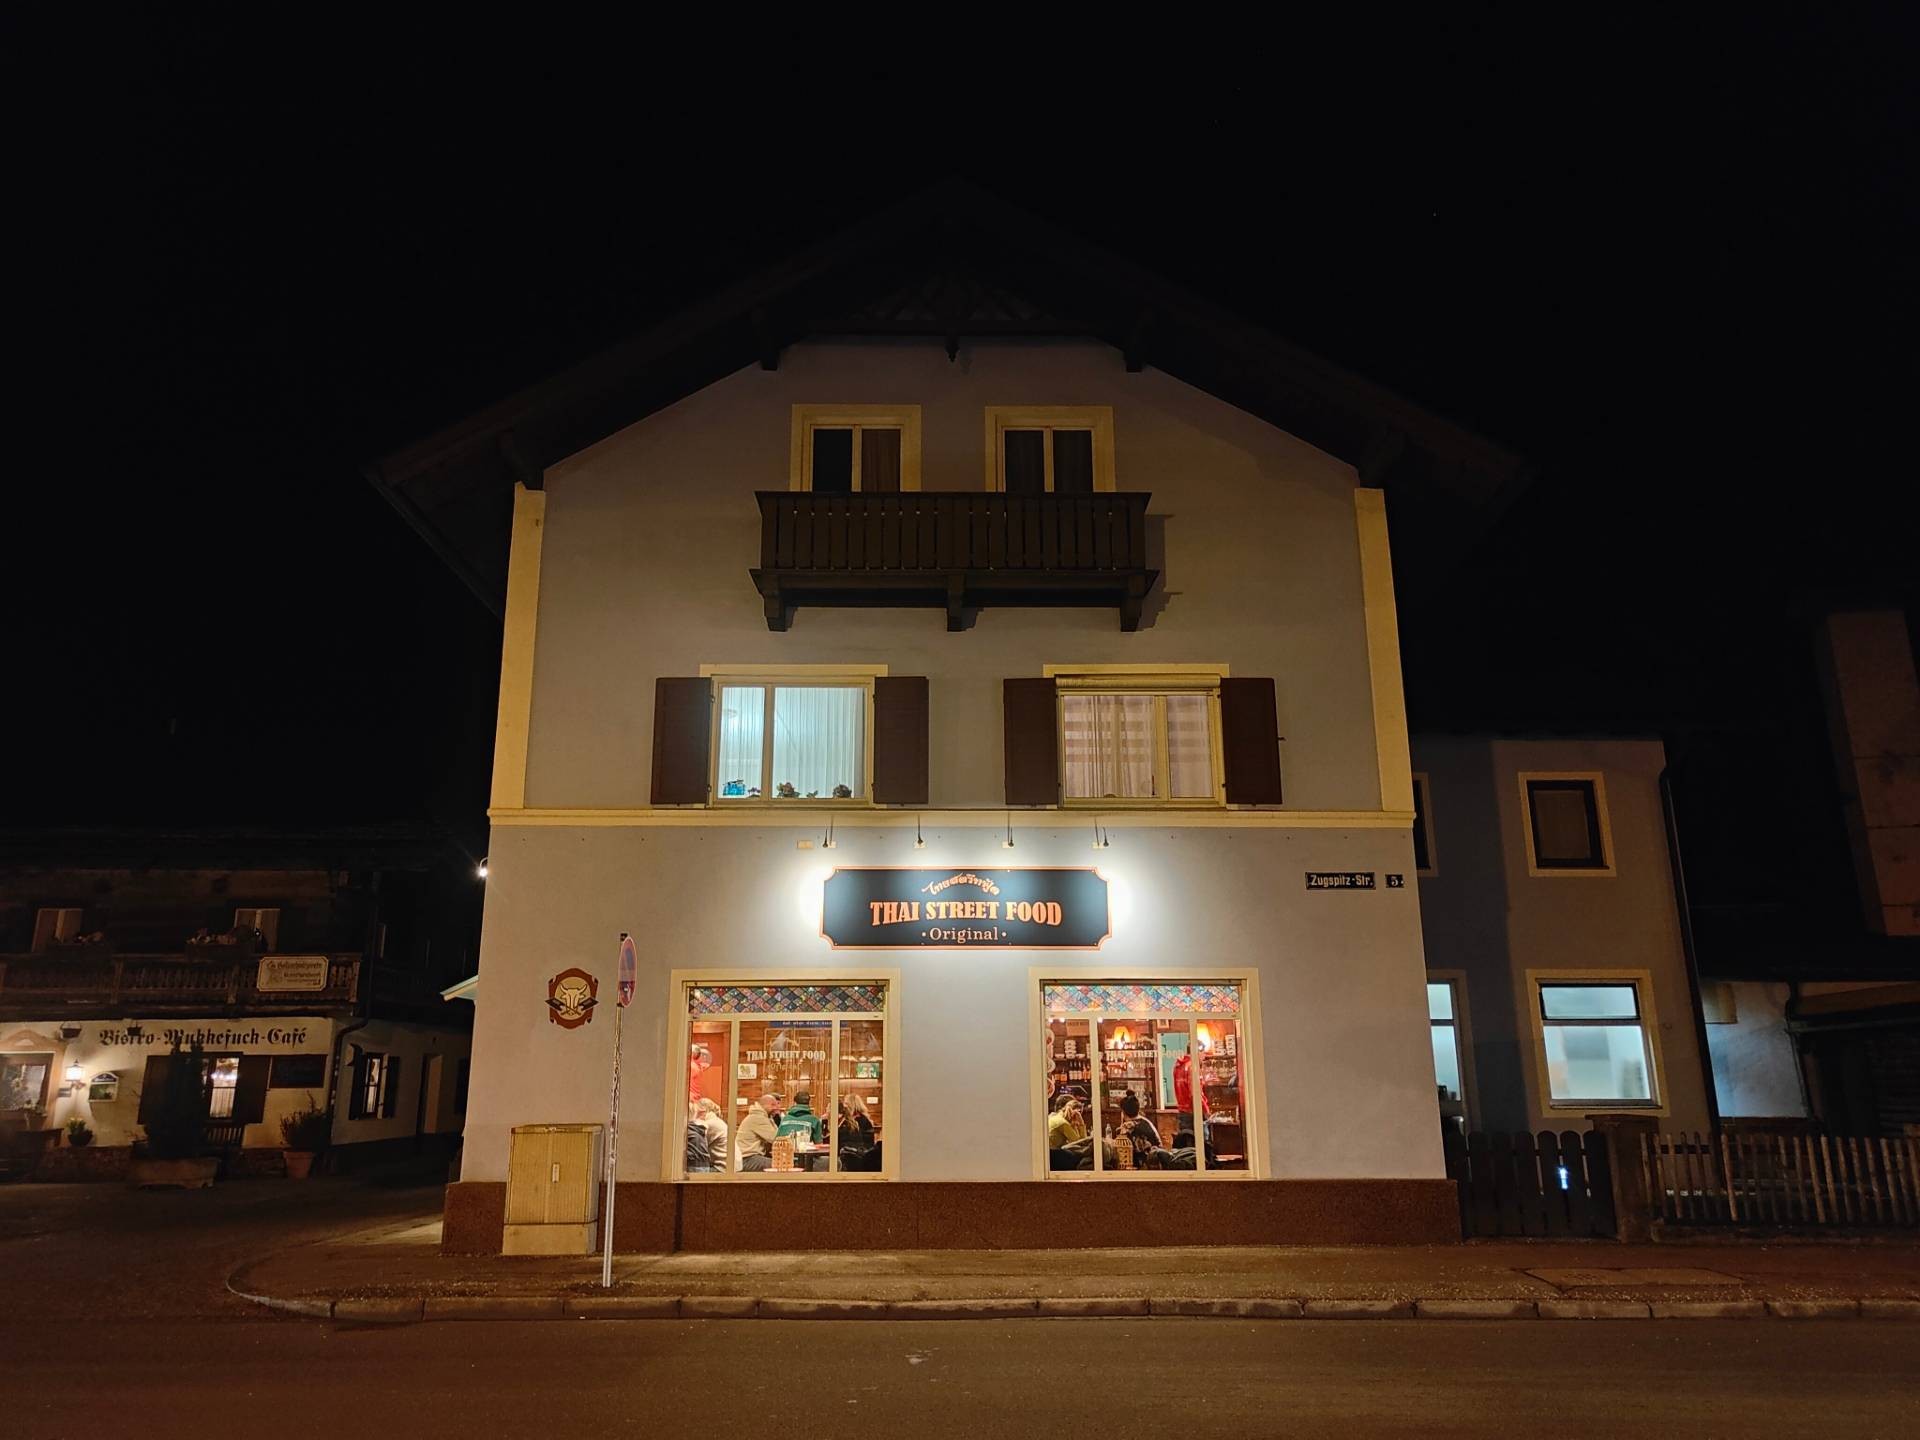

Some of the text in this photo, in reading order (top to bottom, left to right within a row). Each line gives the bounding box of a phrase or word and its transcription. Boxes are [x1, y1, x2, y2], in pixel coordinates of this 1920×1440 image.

[870, 901, 1062, 926] THAI STREET FOOD
[929, 927, 999, 944] Original
[746, 1050, 768, 1062] THAI
[801, 1050, 826, 1061] FOOD
